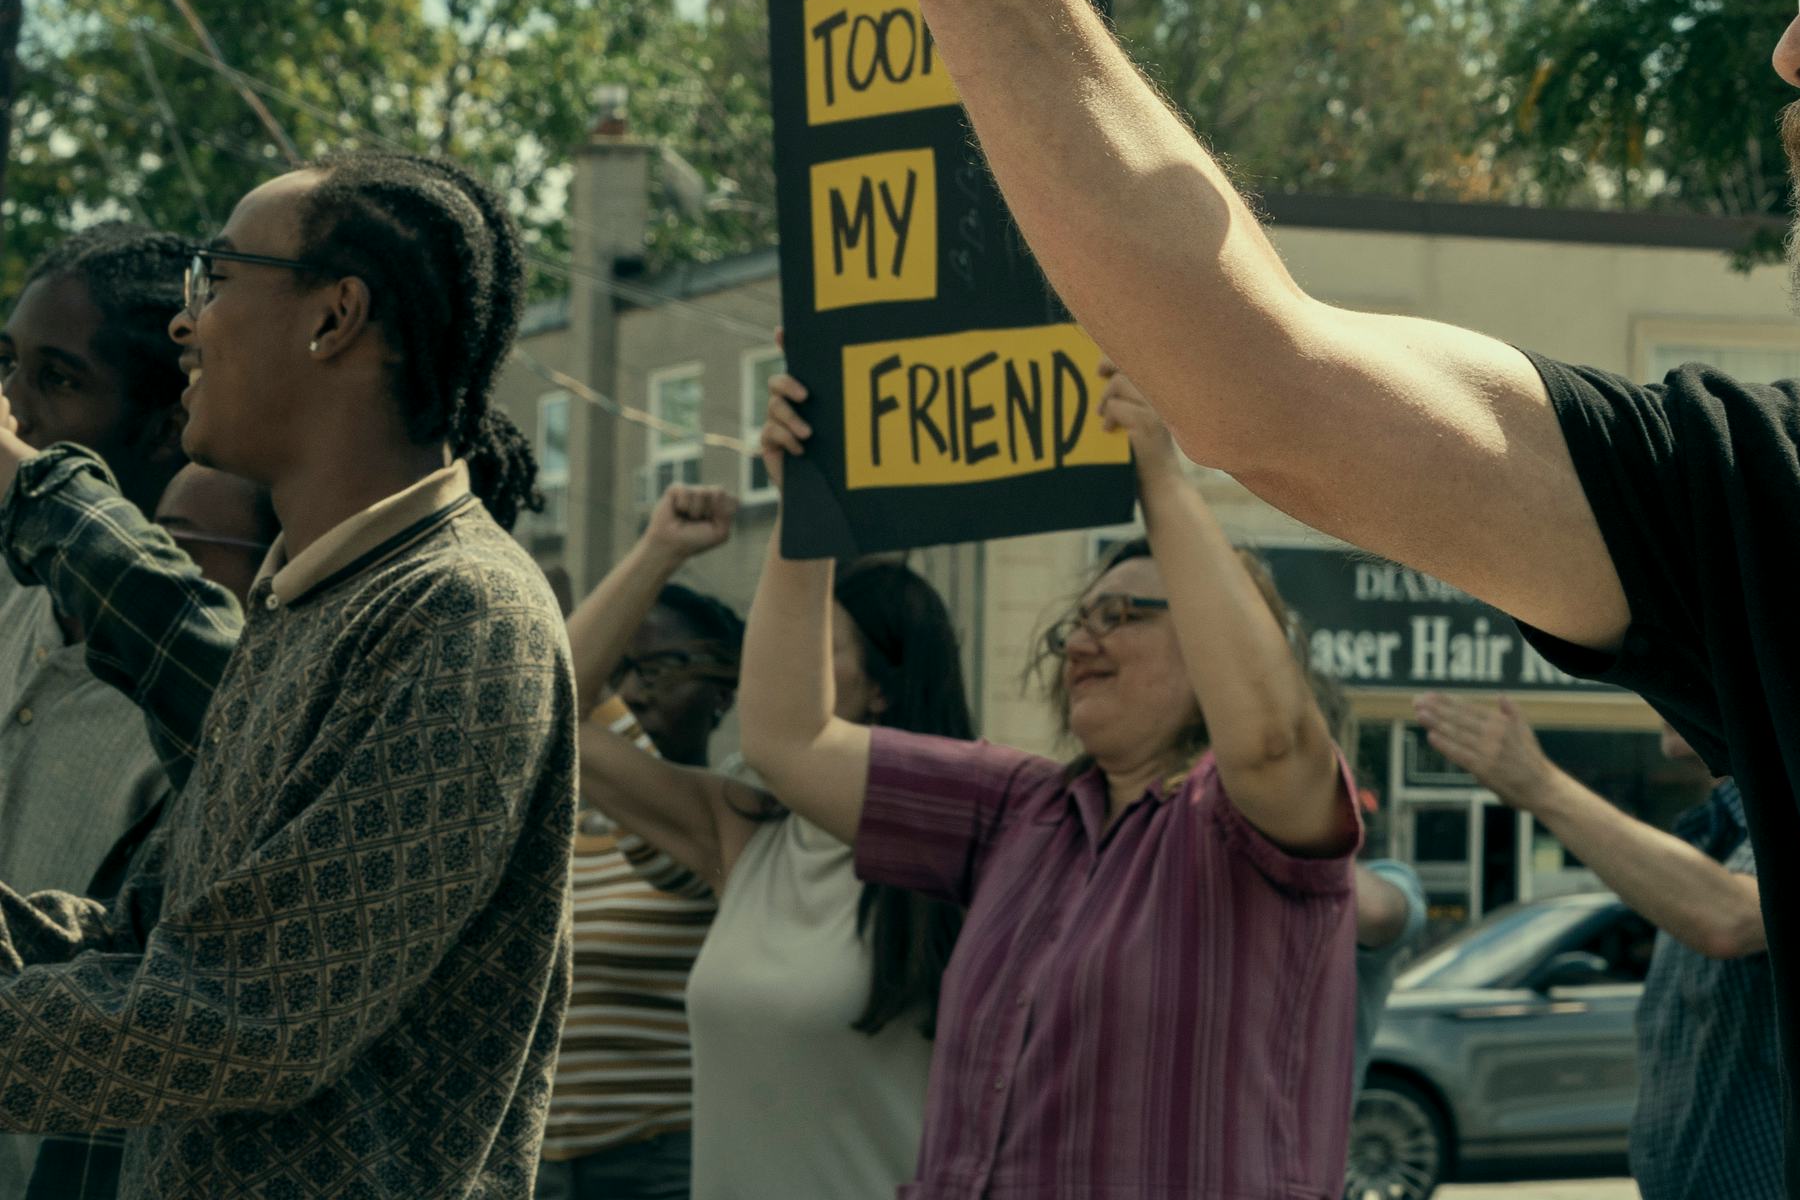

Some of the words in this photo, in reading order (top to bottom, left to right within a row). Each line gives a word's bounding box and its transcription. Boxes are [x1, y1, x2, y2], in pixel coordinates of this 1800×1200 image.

[829, 168, 918, 280] MY
[869, 349, 1089, 469] FRIEND
[1308, 627, 1402, 679] aser
[1409, 615, 1512, 683] Hair
